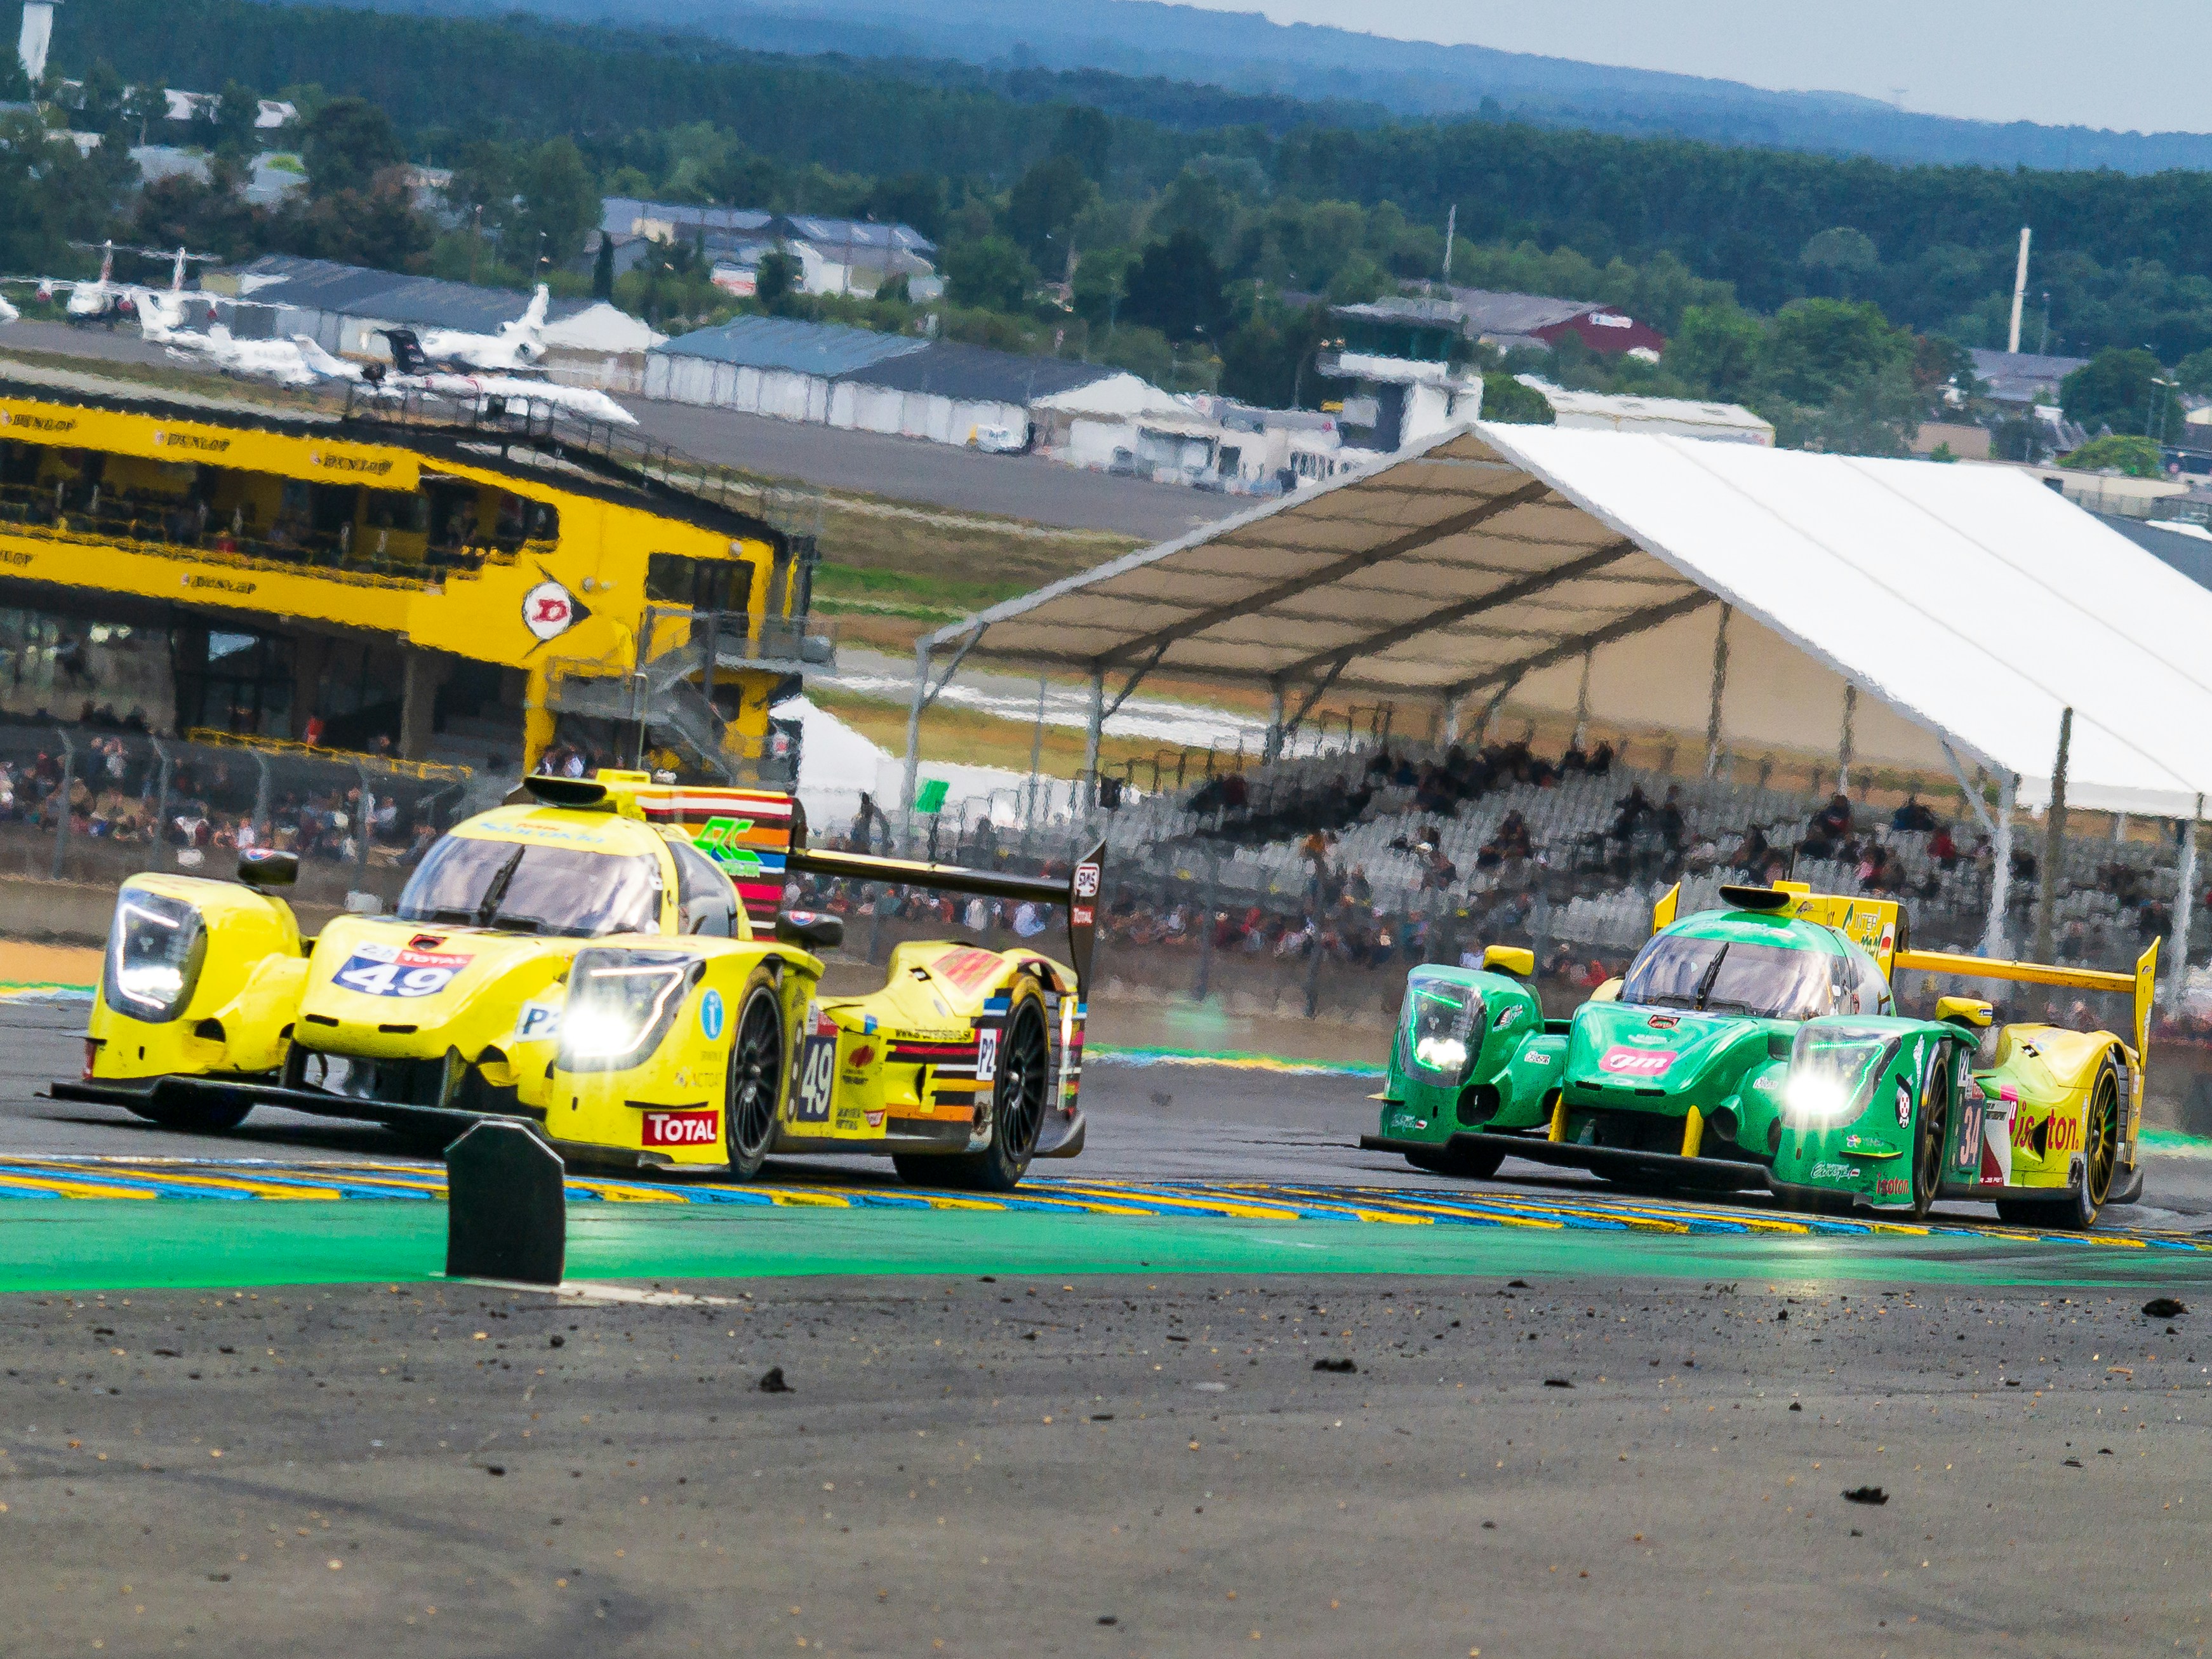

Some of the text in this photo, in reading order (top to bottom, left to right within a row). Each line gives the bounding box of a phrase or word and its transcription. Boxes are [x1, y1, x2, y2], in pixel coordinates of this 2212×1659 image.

[13, 414, 76, 431] DUNLOP
[167, 432, 230, 451] DUNLOP
[324, 454, 392, 476] DUNLOP
[532, 599, 568, 622] D
[402, 953, 469, 965] TOTAL
[341, 963, 453, 997] 49
[980, 1038, 994, 1073] P2
[801, 1043, 833, 1115] 49
[648, 1114, 716, 1142] TOTAL
[1959, 1105, 1982, 1166] 34
